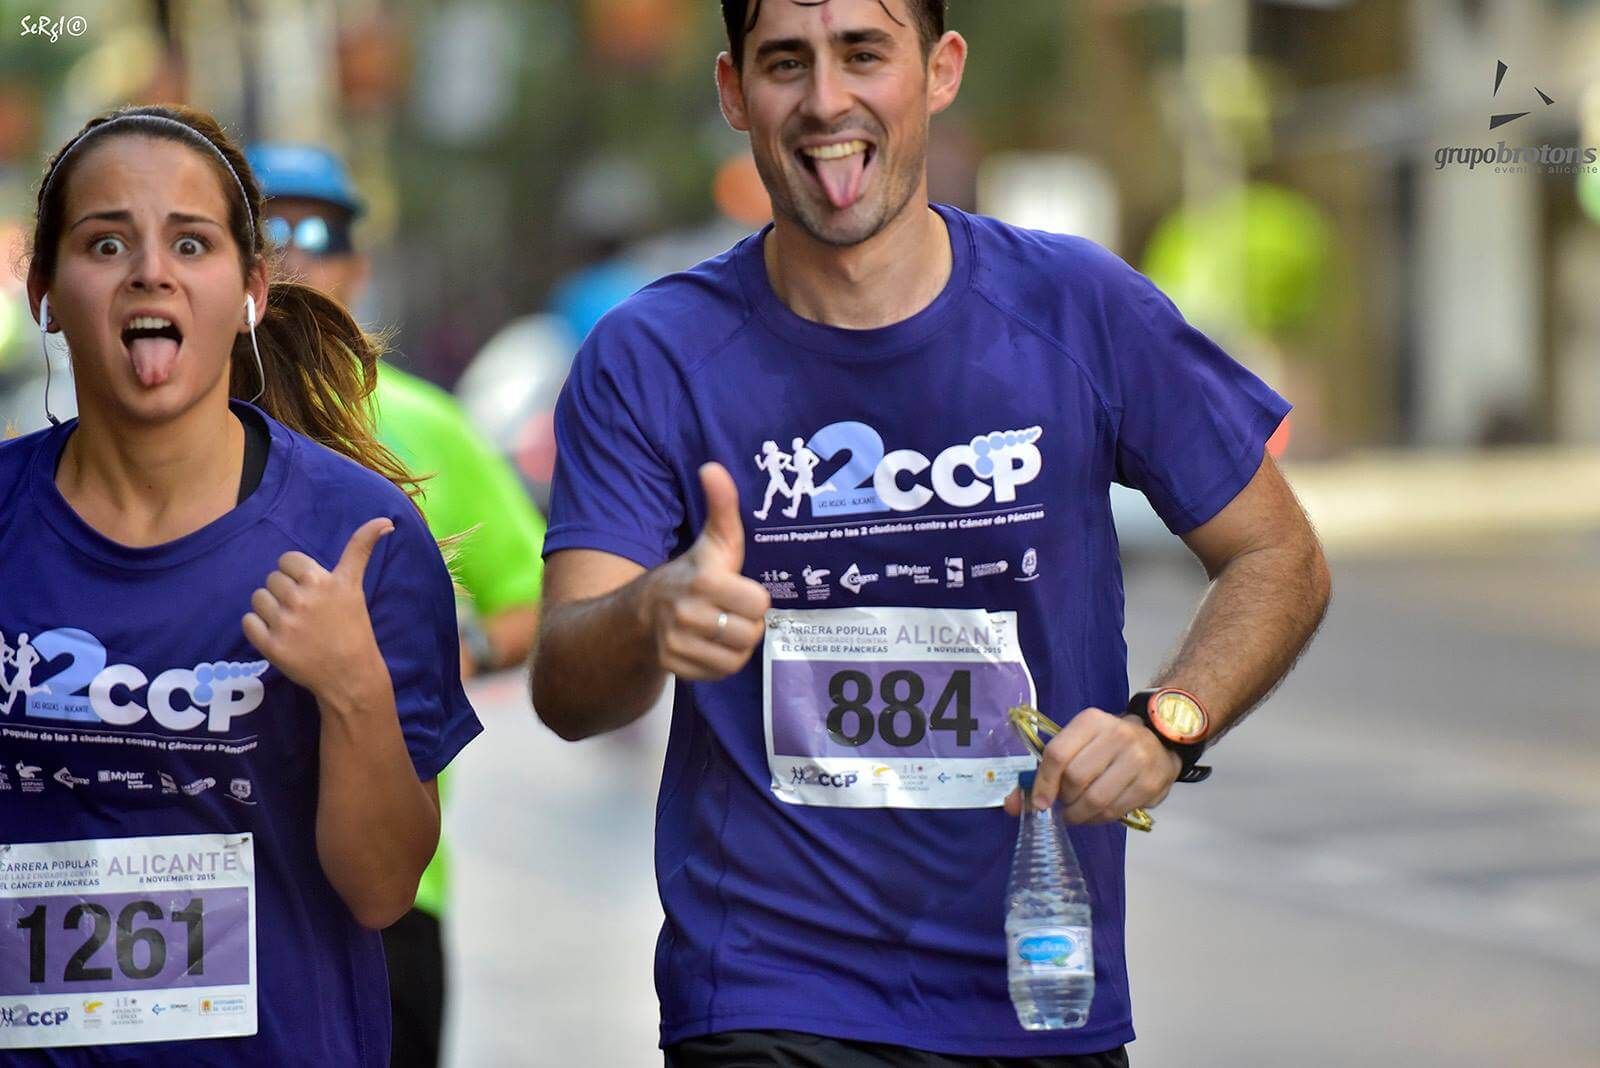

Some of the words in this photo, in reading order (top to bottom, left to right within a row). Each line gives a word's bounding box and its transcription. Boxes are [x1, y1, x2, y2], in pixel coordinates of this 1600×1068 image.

[754, 533, 789, 543] Carrera
[790, 530, 829, 542] Popular
[830, 528, 844, 538] de
[844, 527, 860, 538] las
[860, 526, 868, 536] 2
[869, 522, 913, 535] ciudades
[914, 520, 946, 531] contra
[948, 519, 958, 529] el
[959, 517, 993, 529] Cáncer
[993, 514, 1007, 525] de
[1007, 510, 1045, 523] Páncreas
[836, 626, 888, 635] POPULAR
[895, 624, 1004, 645] ALICAN
[781, 644, 791, 652] EL
[826, 669, 979, 747] 884
[2, 728, 39, 741] Popular
[40, 732, 53, 742] de
[54, 732, 69, 742] las
[71, 733, 78, 742] 2
[79, 734, 124, 744] ciudades
[125, 737, 157, 748] contra
[203, 743, 217, 751] de
[0, 861, 49, 872] CARRERA
[52, 858, 99, 870] POPULAR
[107, 852, 237, 876] ALICANTE
[0, 882, 8, 890] EL
[45, 880, 55, 888] DE
[146, 874, 195, 883] NOVIEMBRE
[197, 873, 216, 881] 2015
[17, 897, 205, 983] 1261
